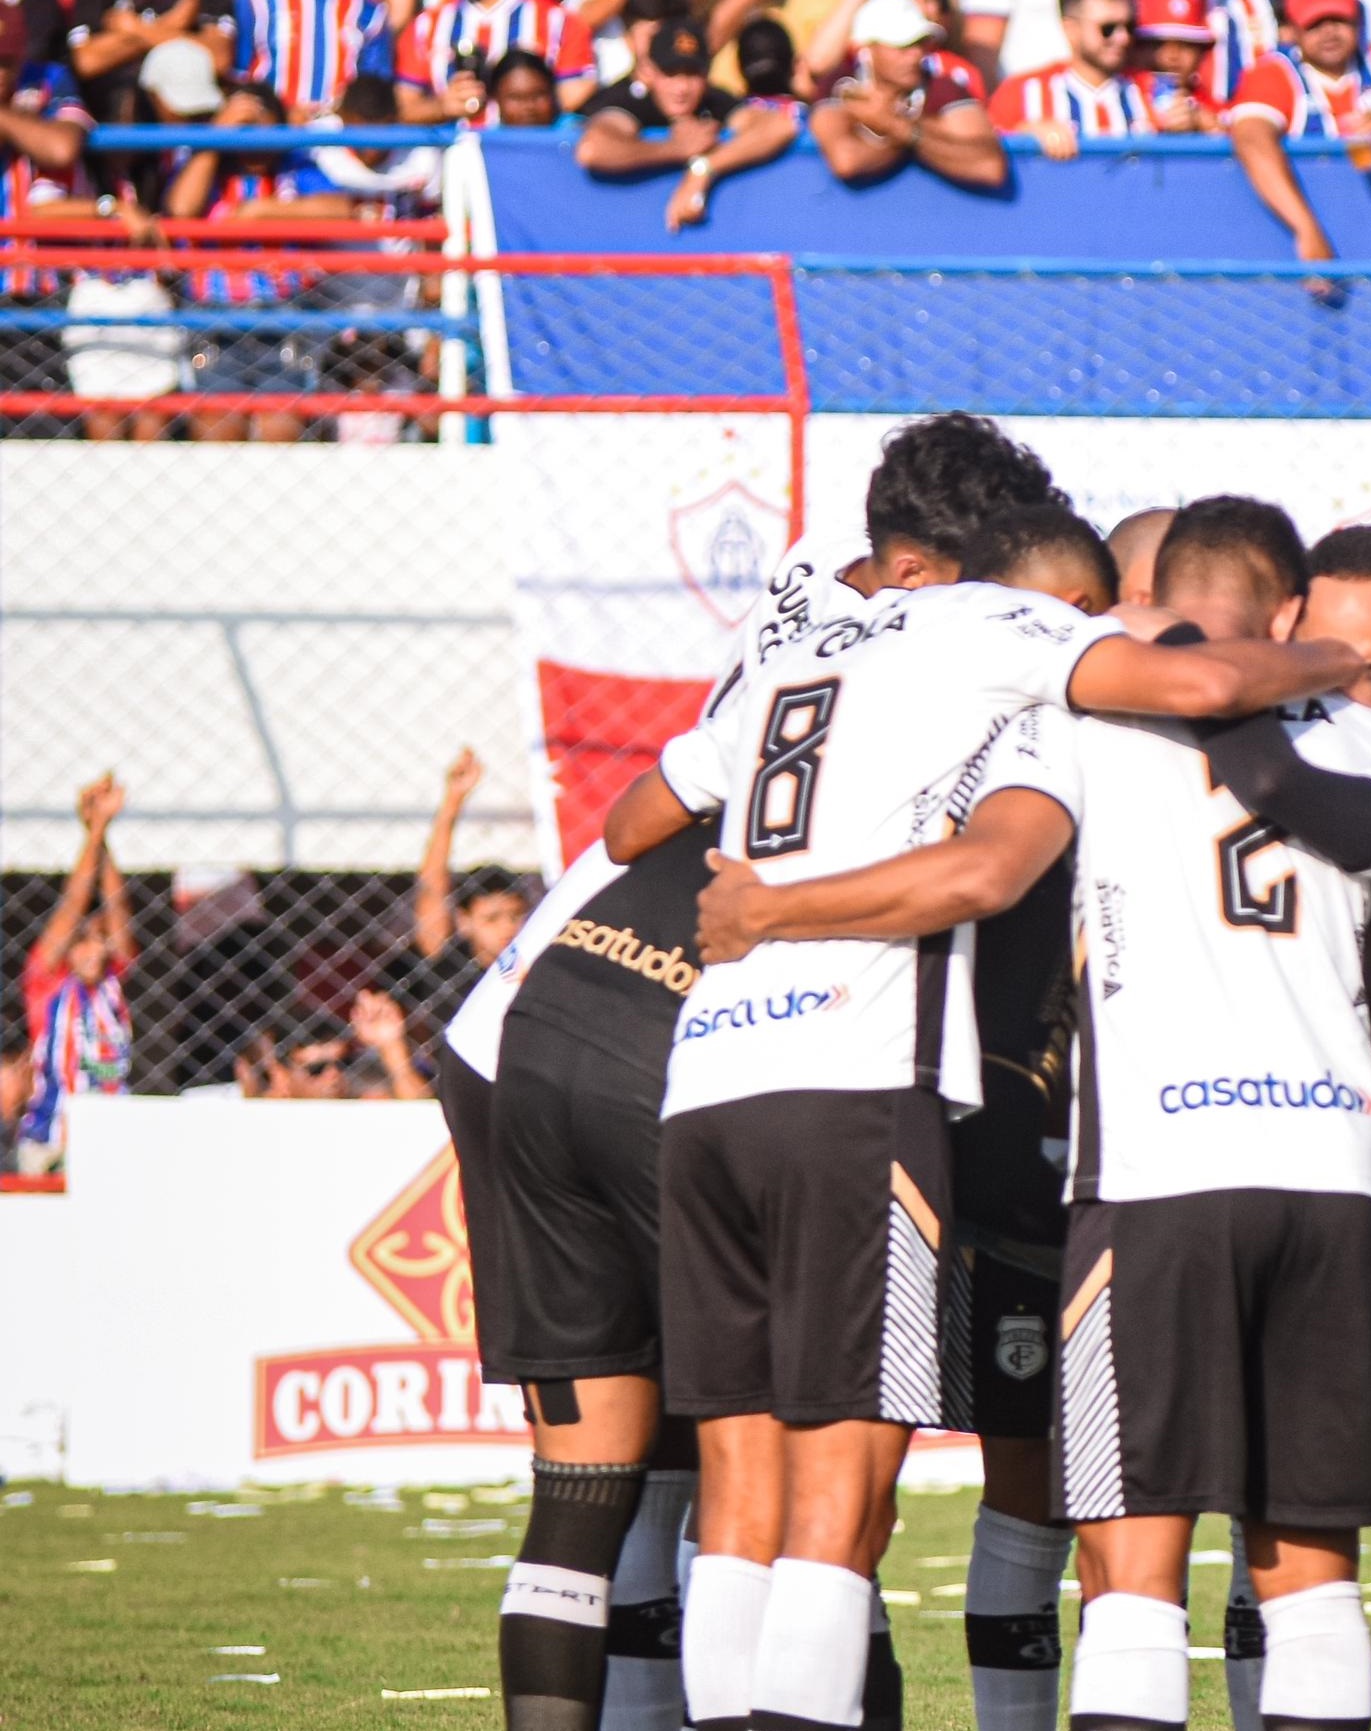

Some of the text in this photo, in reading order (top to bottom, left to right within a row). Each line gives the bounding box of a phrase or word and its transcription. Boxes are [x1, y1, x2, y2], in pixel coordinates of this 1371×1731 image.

[744, 673, 843, 862] 8
[1160, 1070, 1356, 1114] casatudo
[273, 1358, 528, 1443] CORIN
